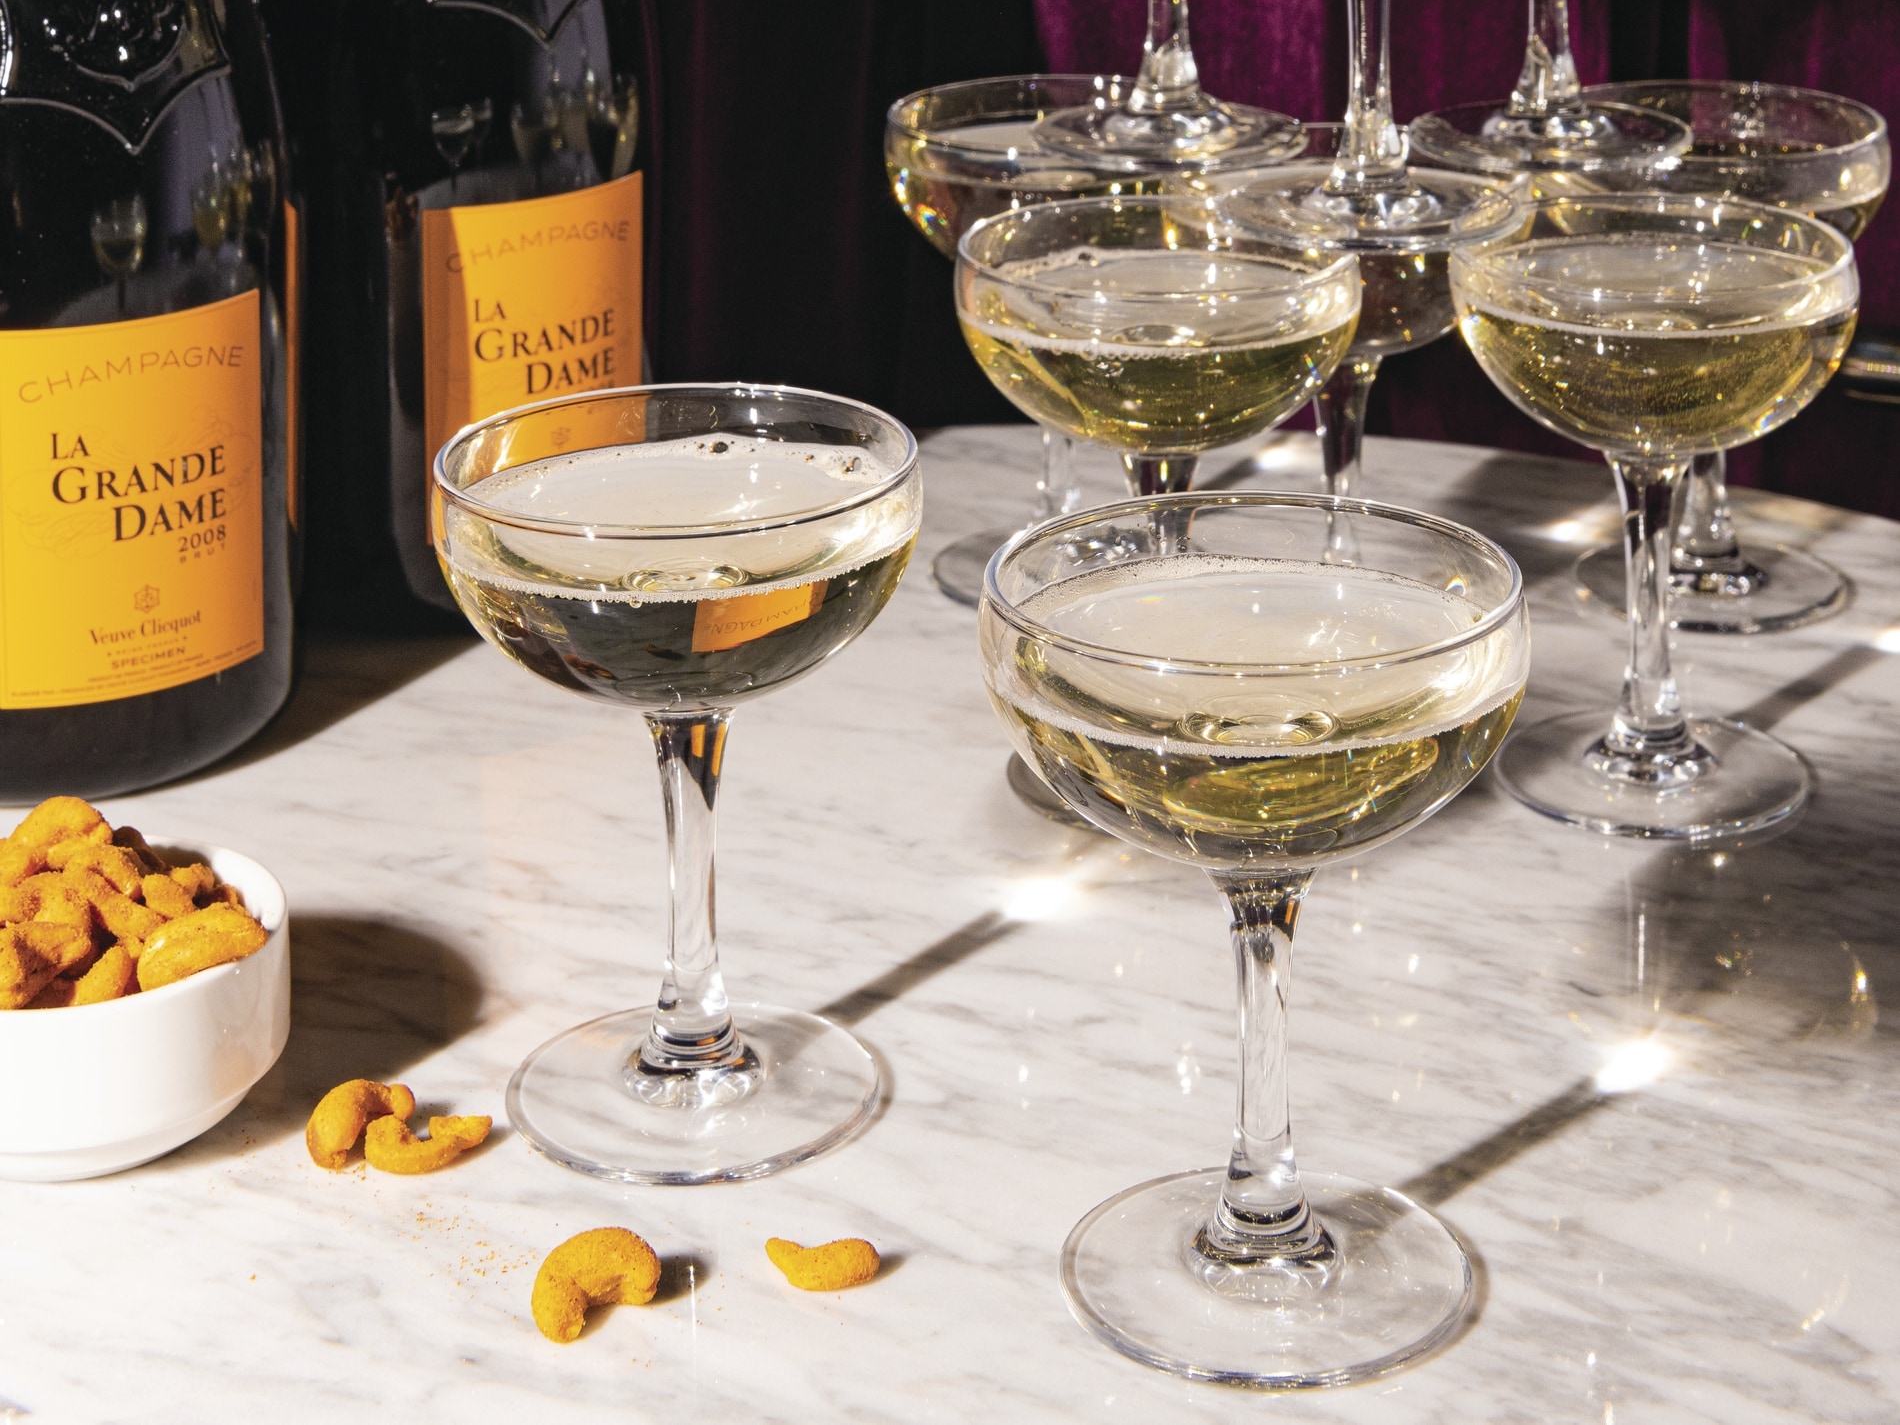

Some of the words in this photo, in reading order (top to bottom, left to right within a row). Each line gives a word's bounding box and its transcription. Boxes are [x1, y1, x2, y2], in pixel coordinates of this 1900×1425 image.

[445, 219, 631, 274] CHAMPAGNE
[474, 299, 507, 323] LA
[474, 308, 616, 363] GRANDE
[18, 346, 244, 404] CHAMPAGNE
[525, 347, 616, 395] DAME
[51, 432, 90, 460] LA
[52, 445, 226, 504] GRANDE
[113, 488, 227, 542] DAME
[178, 524, 227, 553] 2008
[89, 628, 136, 646] Veuve
[140, 611, 202, 638] Clicquot
[111, 646, 187, 670] SPECIMEN
